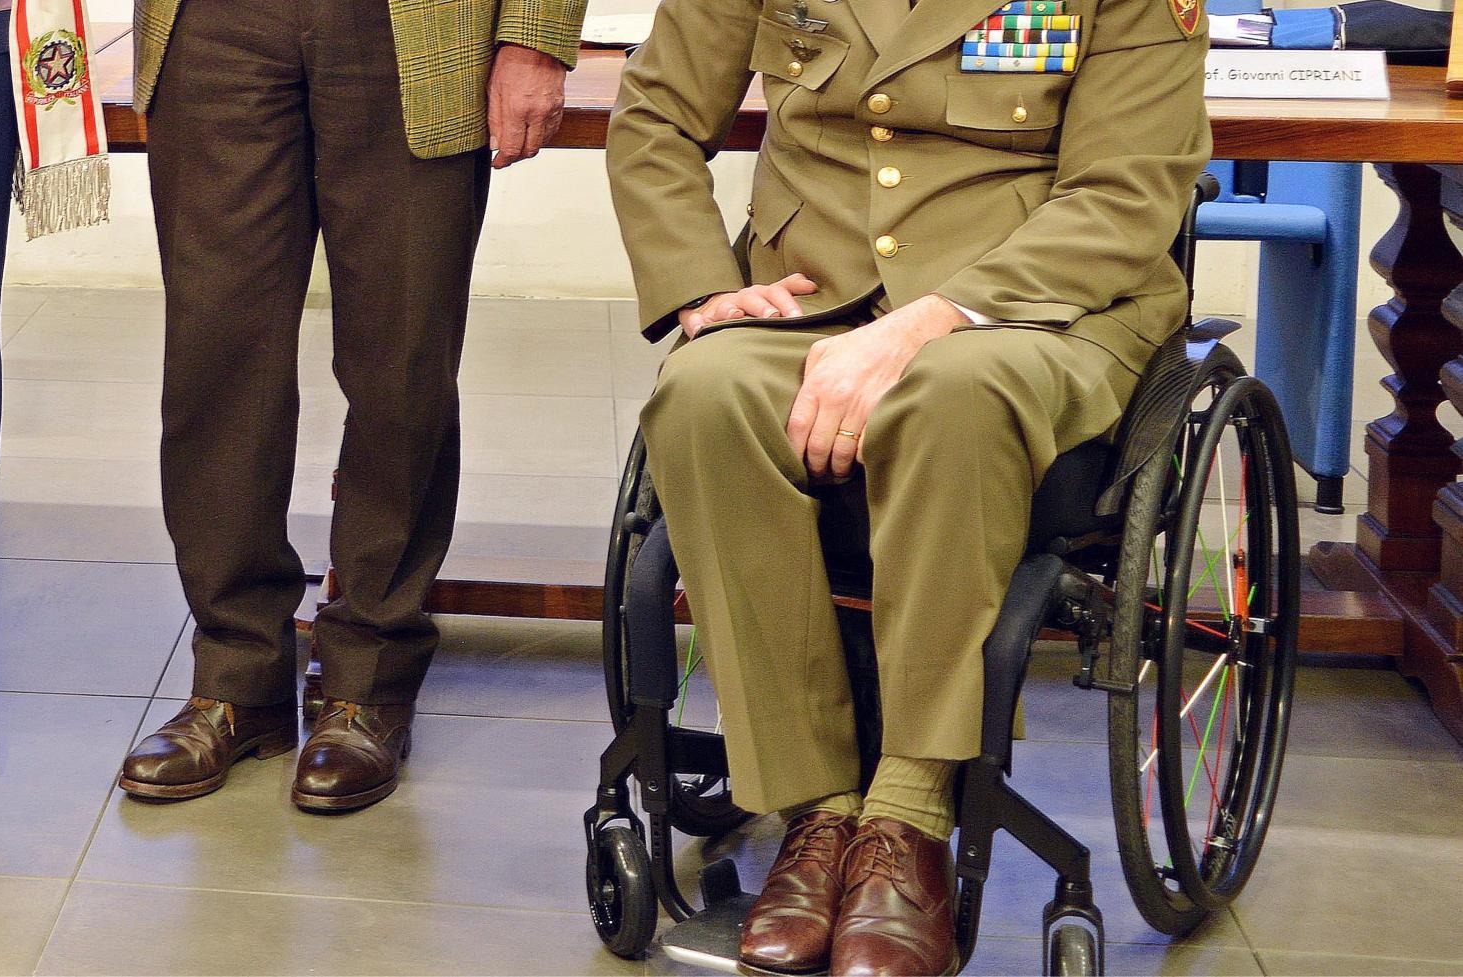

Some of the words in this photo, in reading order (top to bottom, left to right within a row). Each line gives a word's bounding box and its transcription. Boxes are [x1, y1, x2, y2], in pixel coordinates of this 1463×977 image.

[1205, 68, 1224, 81] of.
[1228, 68, 1284, 81] Giovanni
[1289, 70, 1362, 81] CIPRIANI
